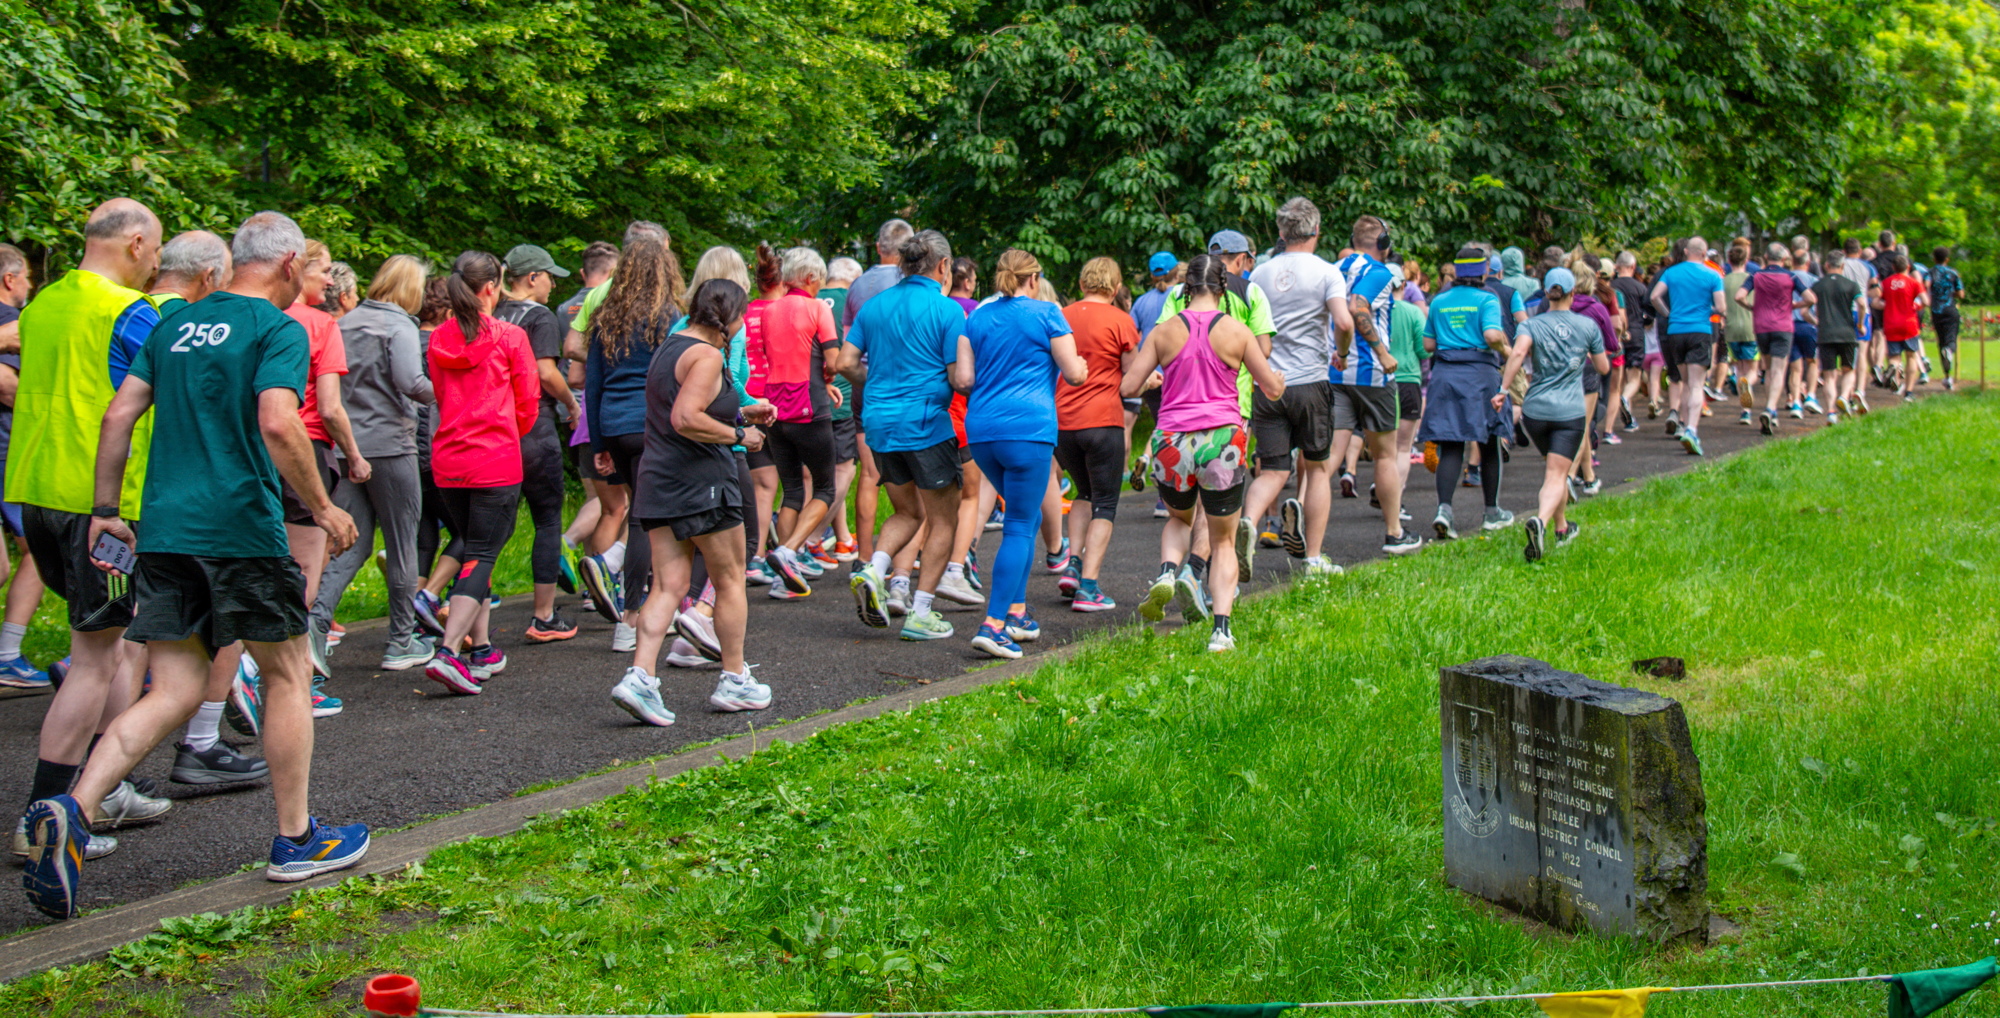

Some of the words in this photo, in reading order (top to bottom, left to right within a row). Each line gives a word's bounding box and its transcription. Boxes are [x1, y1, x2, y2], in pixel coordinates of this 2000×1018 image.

[170, 322, 231, 353] 250
[1511, 721, 1530, 736] THIS
[1594, 741, 1616, 759] WAS
[1513, 759, 1530, 775] THE
[1573, 775, 1614, 800] DEMESNE
[1566, 755, 1589, 772] PART
[1595, 764, 1607, 777] OF
[1519, 780, 1538, 796] WAS
[1542, 788, 1591, 812] PURCHASED
[1596, 803, 1608, 817] BY
[1546, 806, 1580, 829] TRALEE
[1509, 813, 1536, 833] URBAN
[1541, 822, 1579, 847] DISTRICT
[1584, 838, 1623, 862] COUNCIL
[1545, 845, 1555, 858] IN
[1562, 851, 1581, 868] 1922
[1546, 865, 1583, 890] Chairman
